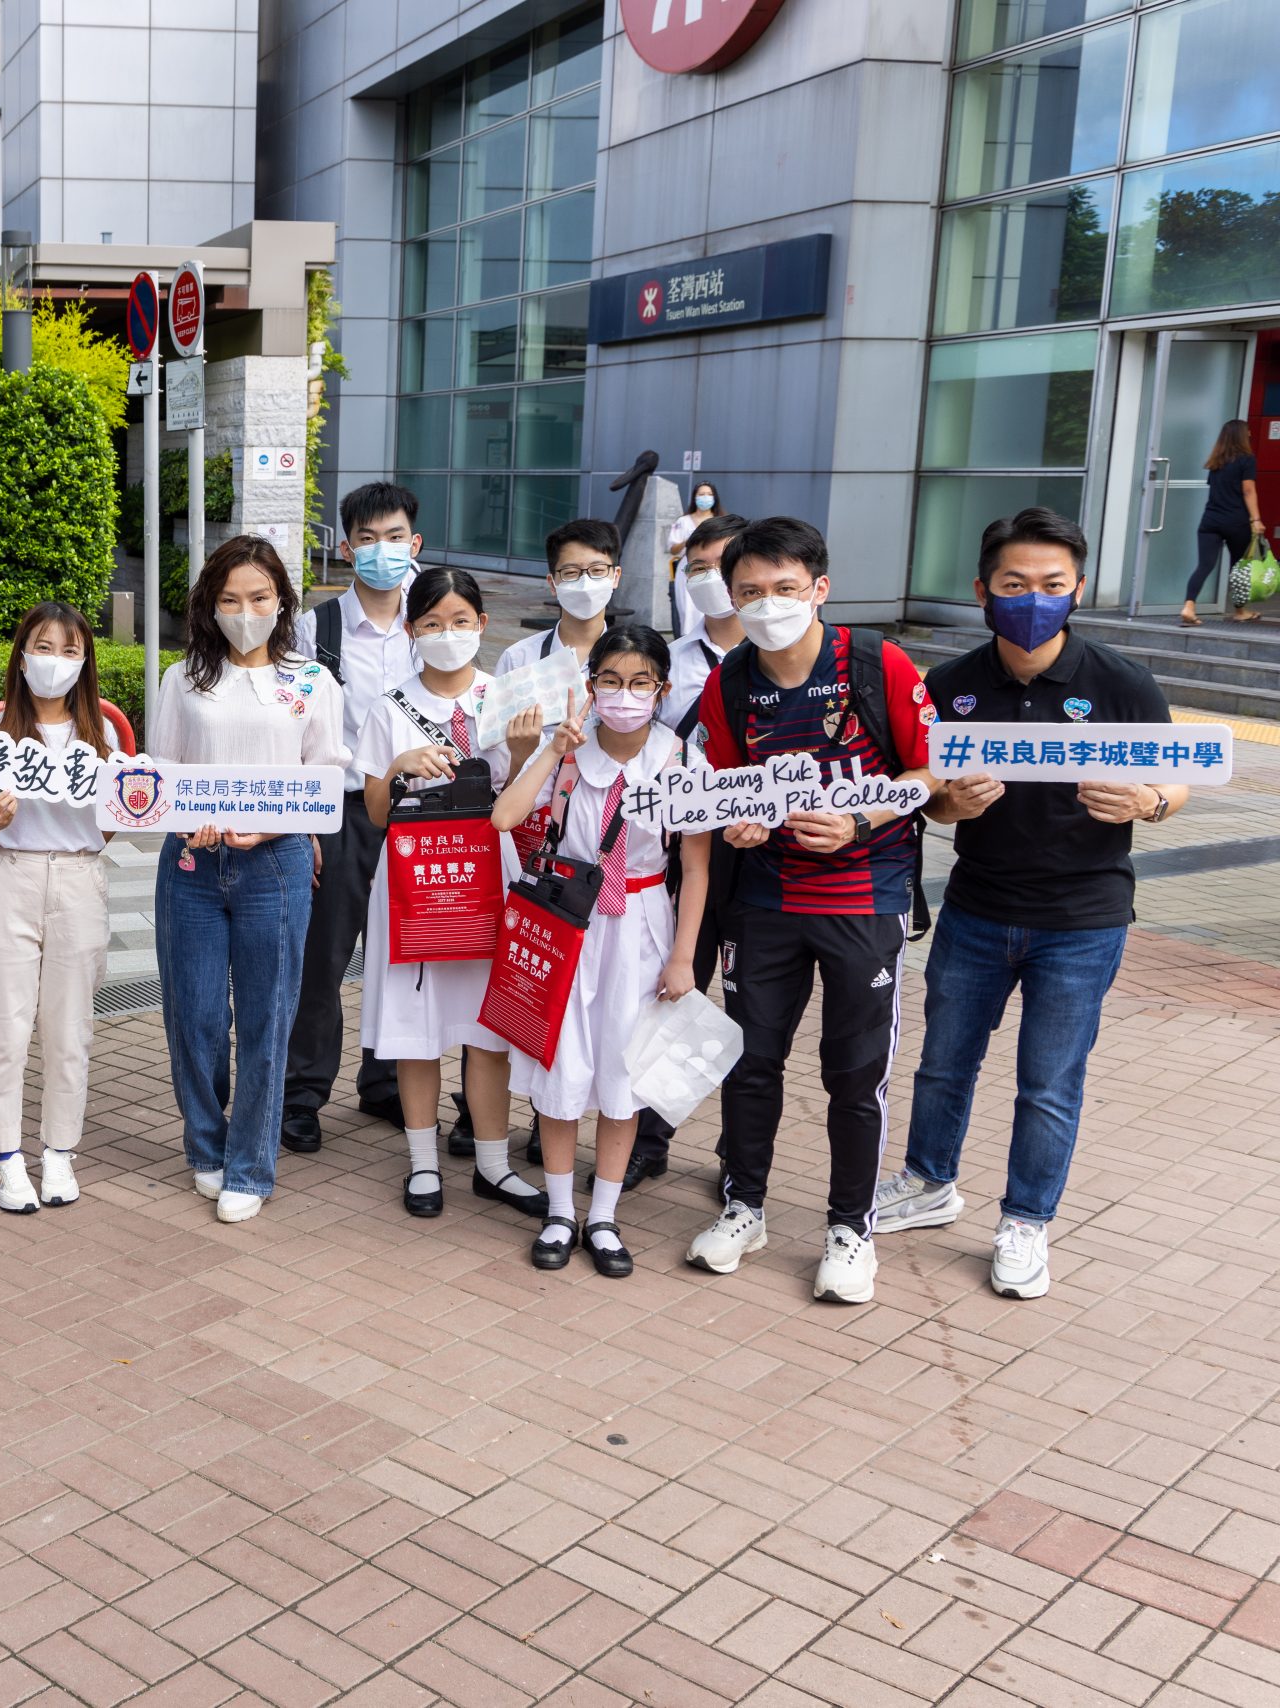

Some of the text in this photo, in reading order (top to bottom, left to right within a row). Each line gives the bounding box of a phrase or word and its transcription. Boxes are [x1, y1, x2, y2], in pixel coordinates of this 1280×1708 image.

[667, 268, 724, 304] 荃灣西站
[666, 298, 745, 321] Tsuen Wan West Station
[808, 682, 850, 697] merc
[399, 697, 421, 721] FILA
[423, 721, 447, 747] FILA
[668, 773, 693, 794] Po
[703, 770, 763, 792] Leung
[773, 760, 813, 783] Kuk
[175, 779, 321, 797] 保良局李城璧中學
[175, 800, 336, 815] Po Leung Kuk Lee Shing Pik College
[669, 785, 921, 825] Lee Shing Pik College
[520, 820, 542, 832] LAG
[420, 835, 464, 847] 保良局
[420, 847, 433, 855] PO
[436, 846, 467, 855] LEUNG
[416, 874, 474, 886] FLAG DAY
[521, 917, 552, 941] 保良局
[530, 933, 551, 951] LEUNG
[508, 952, 548, 982] FLAG DAY
[871, 977, 893, 988] adidas
